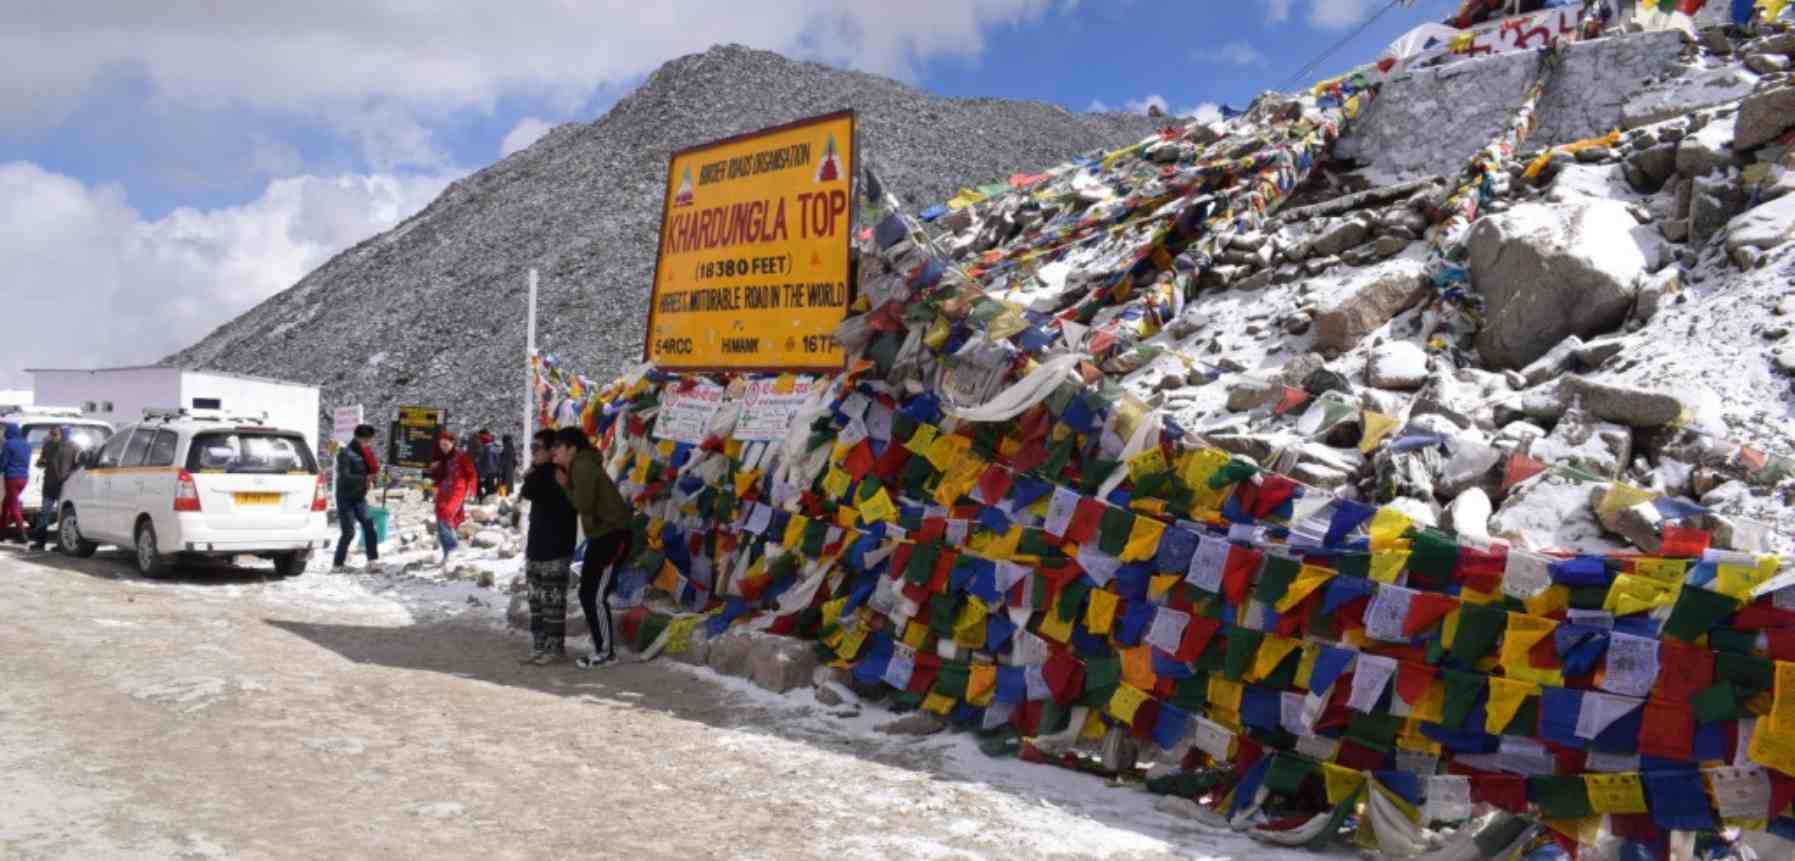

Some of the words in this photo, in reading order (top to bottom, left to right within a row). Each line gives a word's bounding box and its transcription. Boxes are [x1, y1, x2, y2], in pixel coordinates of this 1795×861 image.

[666, 197, 789, 254] KHARDUNGLA
[798, 190, 846, 239] TOP
[744, 285, 769, 308] ROAD
[783, 283, 804, 308] THE
[806, 281, 845, 307] WORLD
